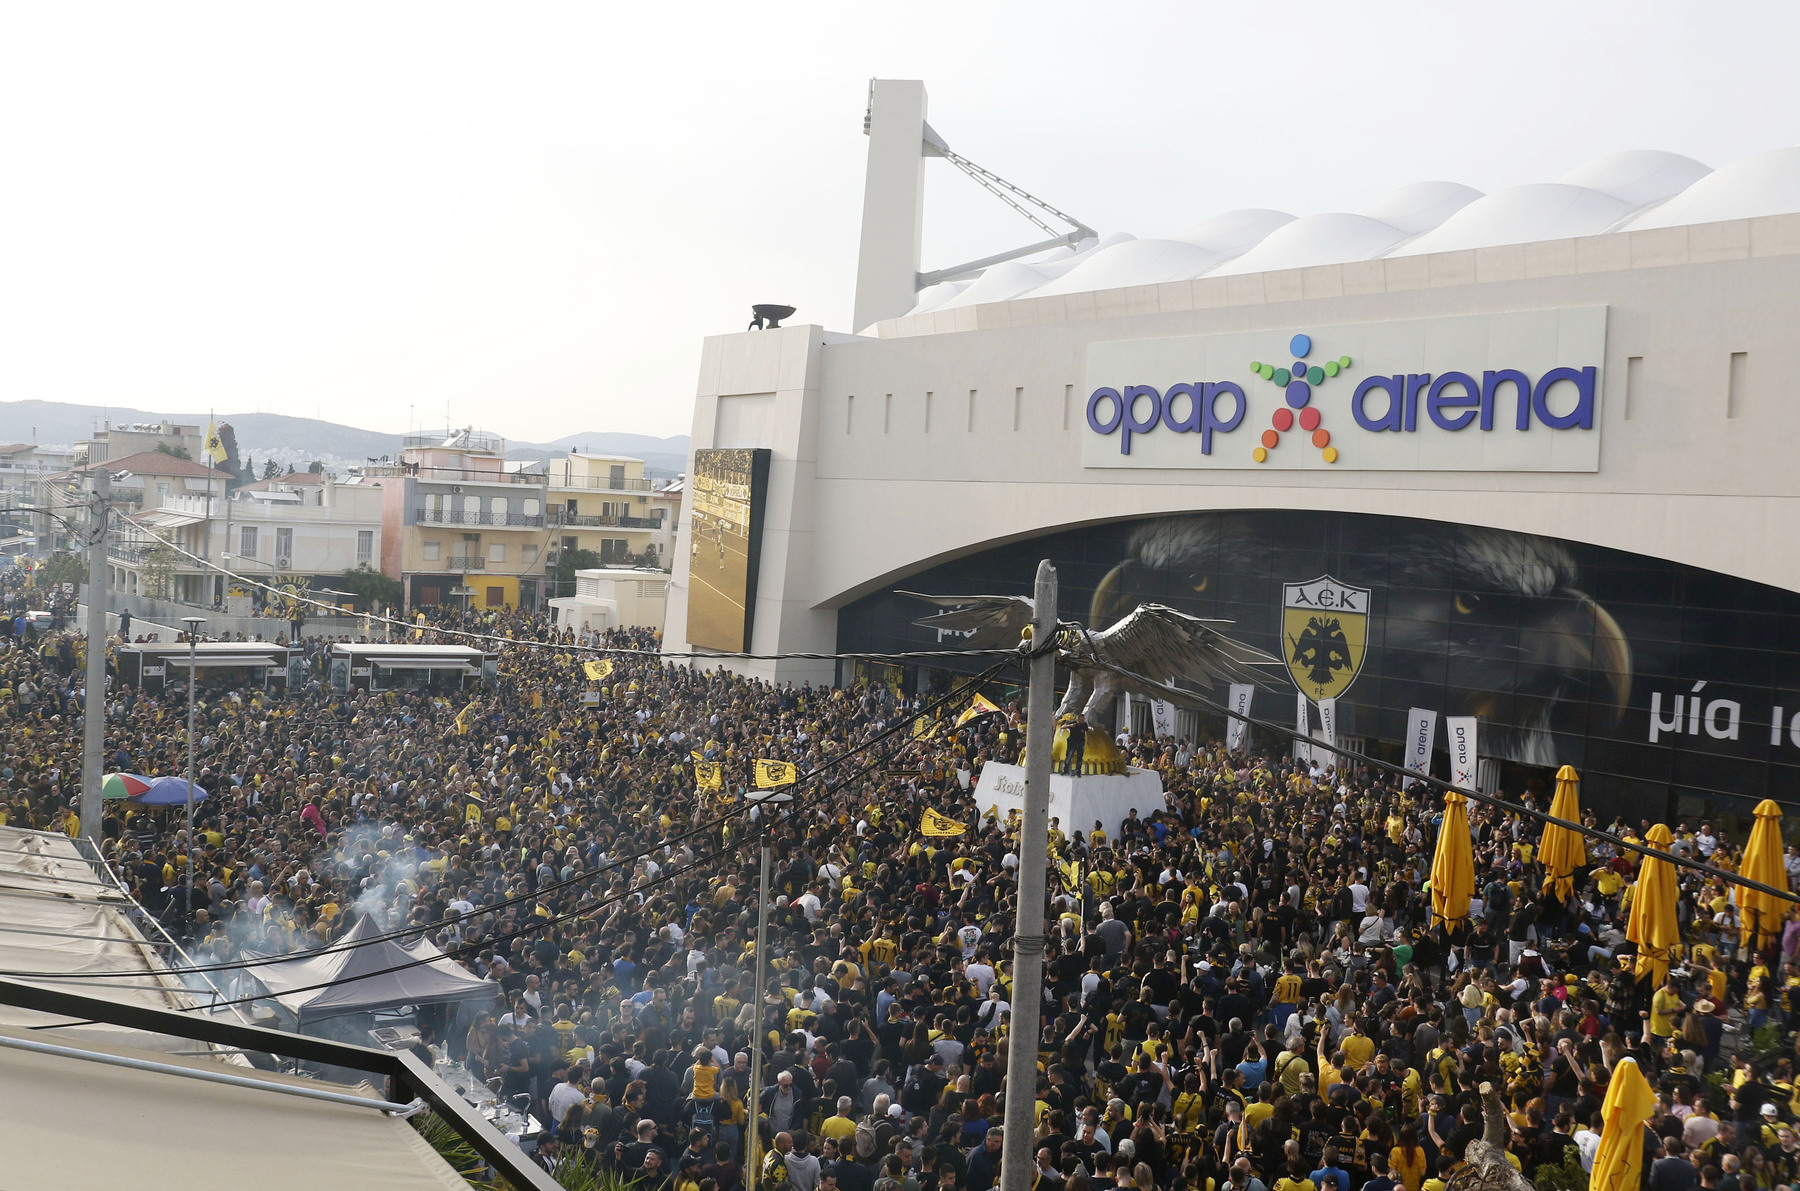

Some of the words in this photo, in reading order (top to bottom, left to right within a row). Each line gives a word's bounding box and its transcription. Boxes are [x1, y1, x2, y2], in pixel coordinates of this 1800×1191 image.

[1086, 380, 1247, 455] opap
[1351, 366, 1597, 432] arena
[1417, 719, 1429, 756] arena
[877, 946, 889, 961] 17
[1287, 982, 1298, 1001] 11
